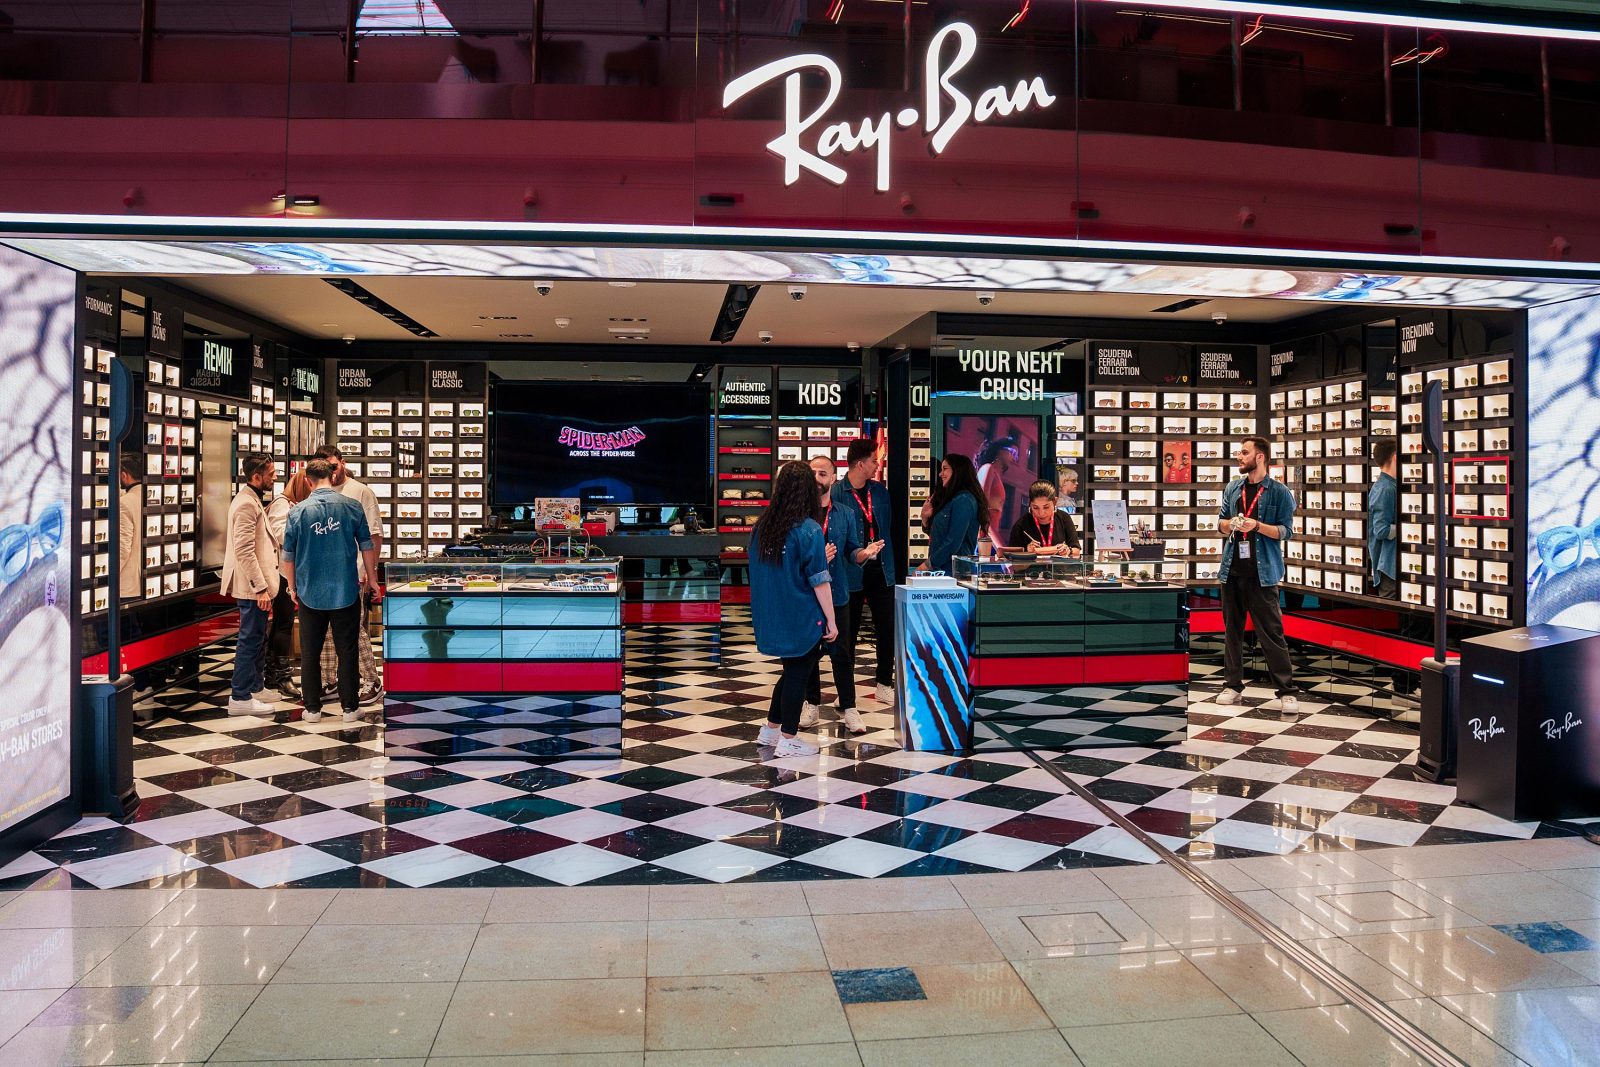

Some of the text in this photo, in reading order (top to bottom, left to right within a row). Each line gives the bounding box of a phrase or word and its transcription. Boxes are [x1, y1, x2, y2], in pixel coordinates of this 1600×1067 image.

[152, 310, 162, 326] THE
[152, 325, 166, 341] ICONS
[1401, 321, 1434, 341] TRENDING
[1401, 338, 1417, 354] NOW
[203, 340, 233, 376] REMIX
[1098, 348, 1133, 359] SCUDERIA
[1200, 352, 1233, 363] SCUDERIA
[1271, 350, 1294, 366] TRENDING
[958, 349, 1065, 374] YOUR NEXT
[1098, 358, 1127, 367] FERRARI
[1200, 361, 1228, 370] FERRARI
[338, 368, 366, 378] URBAN
[431, 369, 458, 379] URBAN
[1098, 366, 1140, 377] COLLECTION
[1200, 369, 1240, 379] COLLECTION
[1271, 365, 1282, 377] NOW
[296, 368, 307, 391] THE
[338, 377, 372, 388] CLASSIC
[431, 378, 463, 389] CLASSIC
[725, 382, 766, 392] AUTHENTIC
[980, 377, 1044, 401] CRUSH
[720, 394, 770, 405] ACCESSORIES
[798, 383, 842, 406] KIDS
[558, 426, 646, 450] SPIDER-MAN
[933, 592, 964, 600] ANNIVERSARY
[0, 731, 31, 760] Y-BAN
[31, 719, 63, 750] STORES
